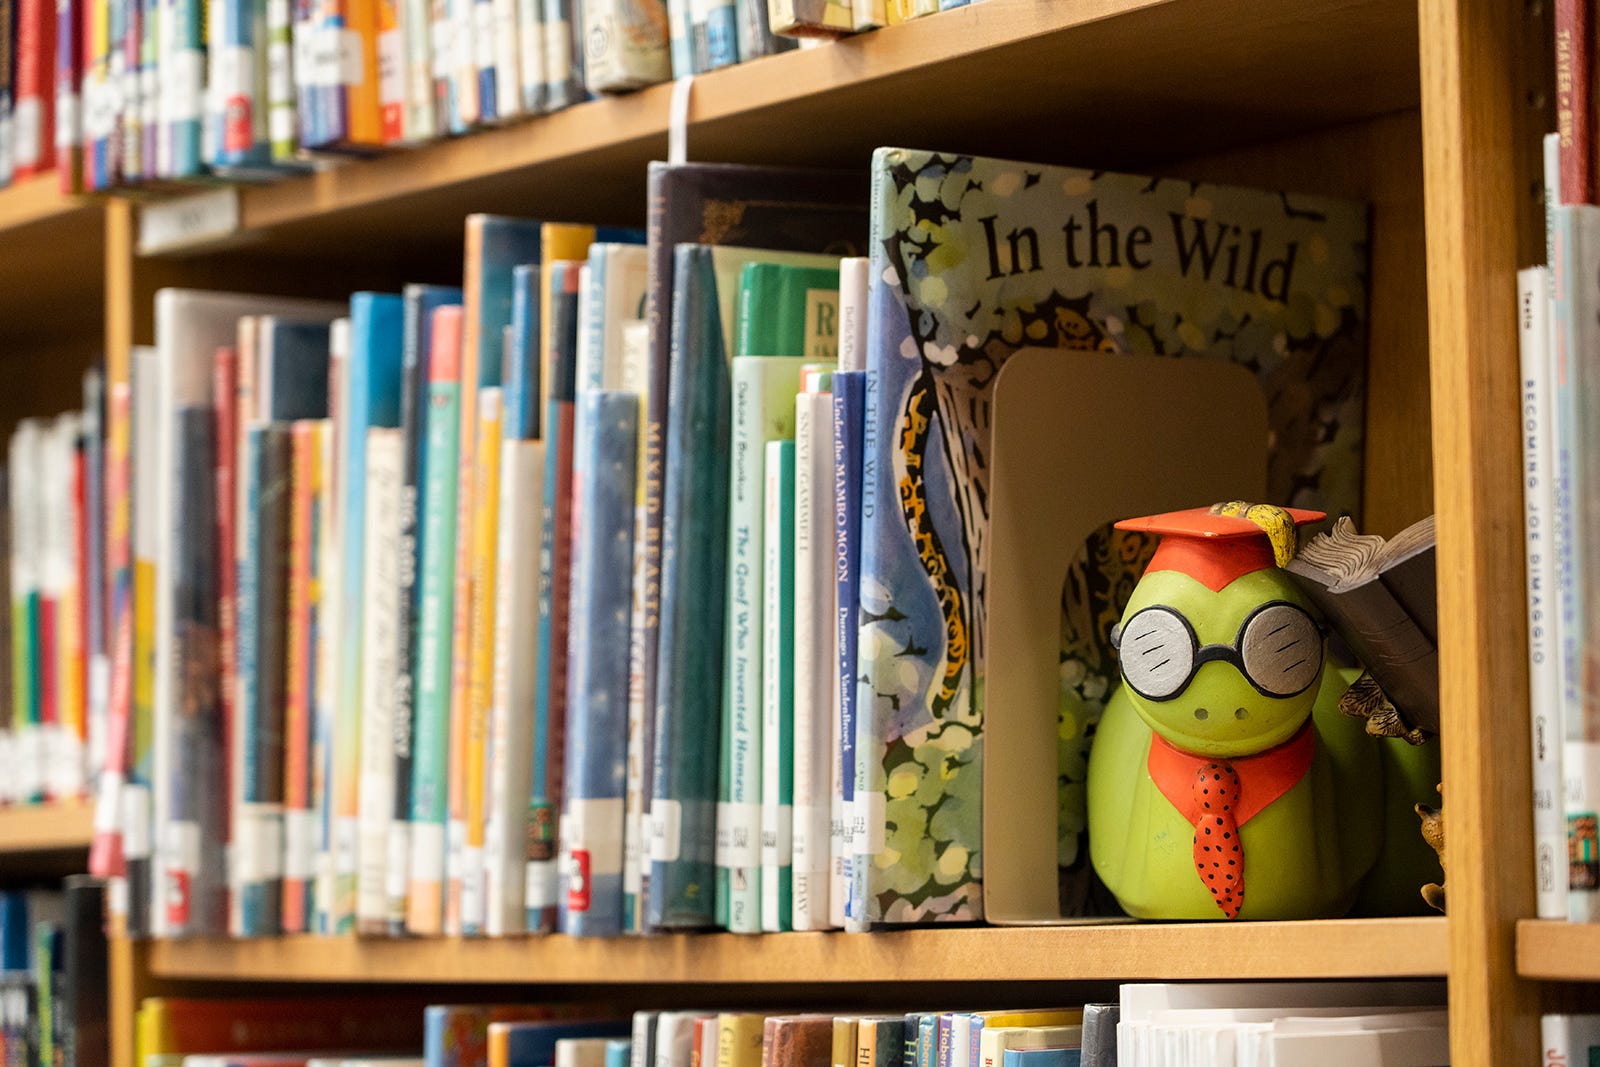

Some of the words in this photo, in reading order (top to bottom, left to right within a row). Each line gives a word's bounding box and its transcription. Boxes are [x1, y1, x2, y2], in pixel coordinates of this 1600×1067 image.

[978, 214, 1043, 280] In
[1063, 199, 1153, 271] the
[1168, 210, 1299, 304] Wild
[866, 369, 879, 394] IN
[833, 396, 845, 438] Under
[865, 404, 877, 450] THE
[1525, 379, 1540, 490] BECOMING
[646, 420, 661, 515] MIXED
[834, 440, 847, 461] the
[834, 463, 848, 527] MAMBO
[862, 458, 876, 520] WILD
[736, 525, 750, 557] The
[1527, 503, 1541, 542] JOE
[645, 526, 660, 630] BEASTS
[836, 529, 849, 584] MOON
[734, 562, 749, 606] Goof
[736, 611, 750, 651] Who
[838, 607, 849, 656] Durango
[1529, 553, 1546, 666] DIMAGGIO
[735, 656, 749, 733] Invented
[841, 673, 853, 752] VandenBroeck
[734, 738, 748, 803] Homew
[922, 1026, 935, 1067] Hober
[940, 1027, 951, 1067] Hober
[969, 1028, 980, 1067] Hober
